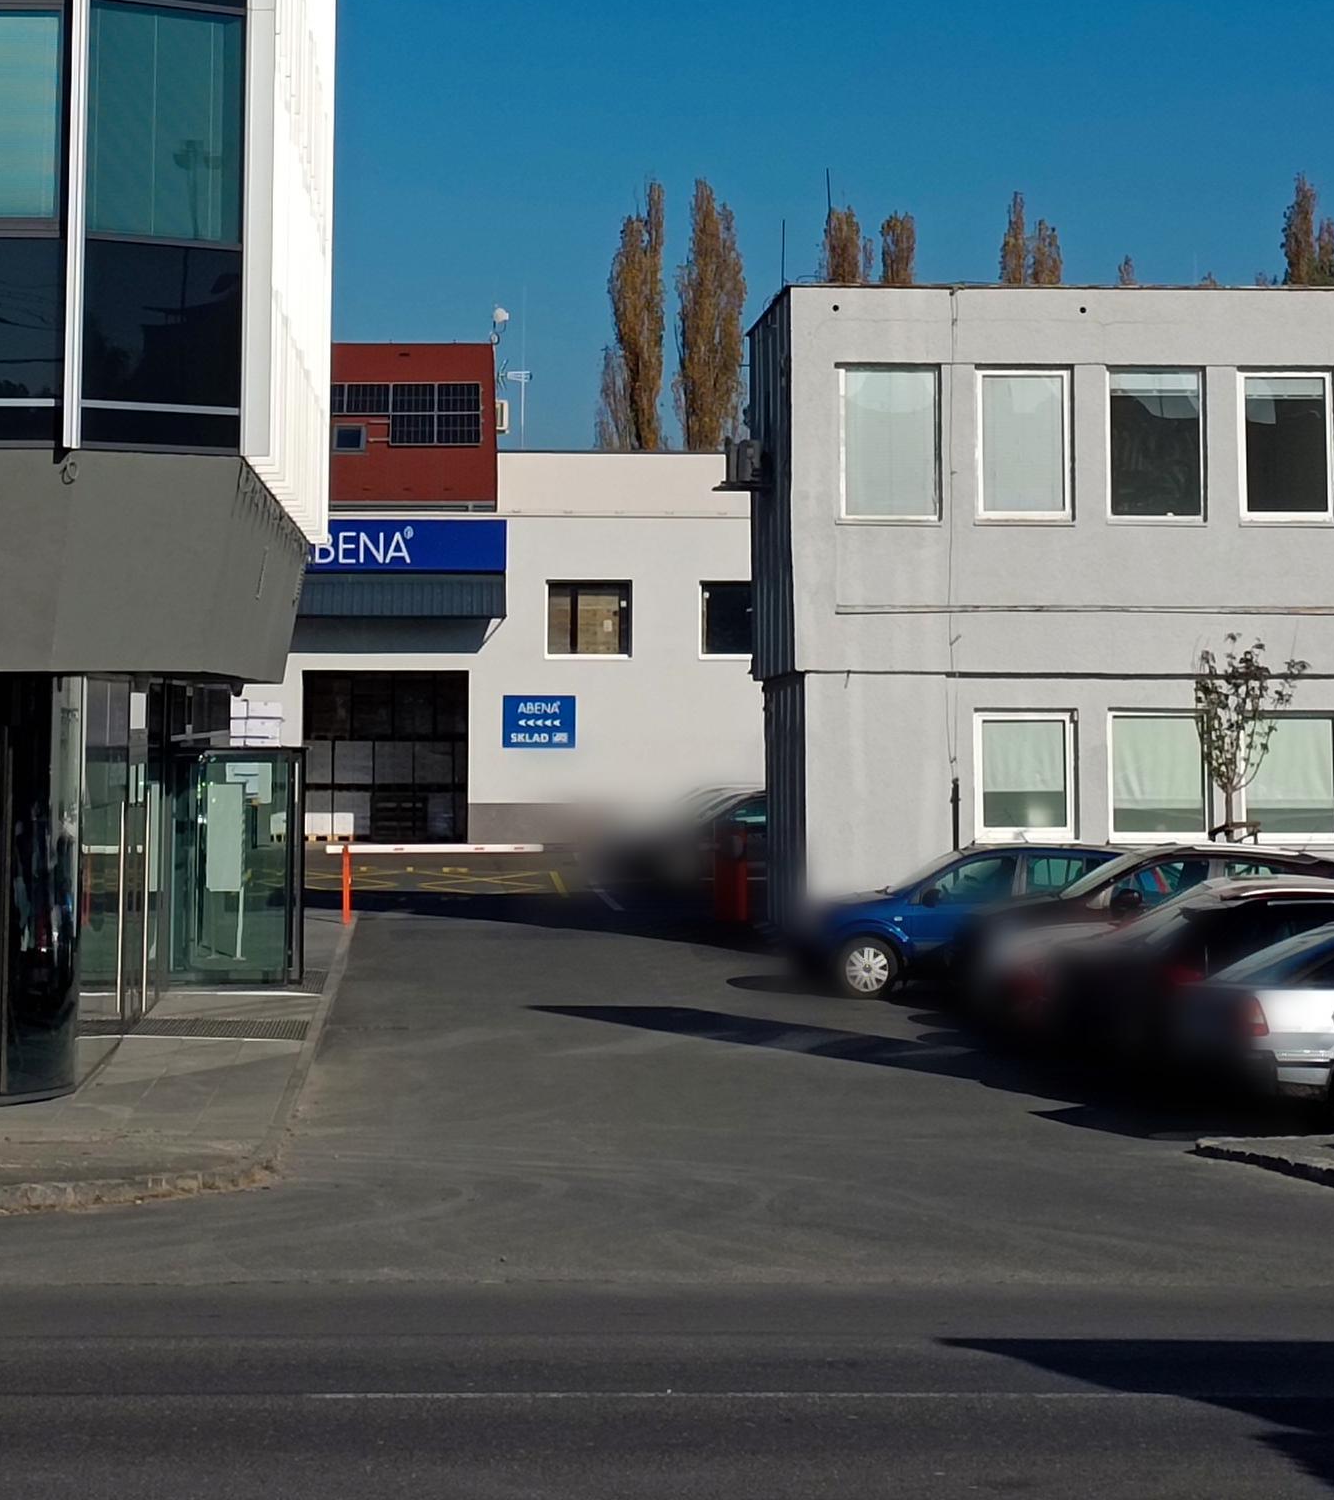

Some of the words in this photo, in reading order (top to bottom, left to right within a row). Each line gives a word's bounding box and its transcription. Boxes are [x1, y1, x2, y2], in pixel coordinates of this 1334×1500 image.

[308, 531, 411, 565] BENA
[517, 702, 560, 714] ABENA
[510, 732, 550, 743] SKLAD
